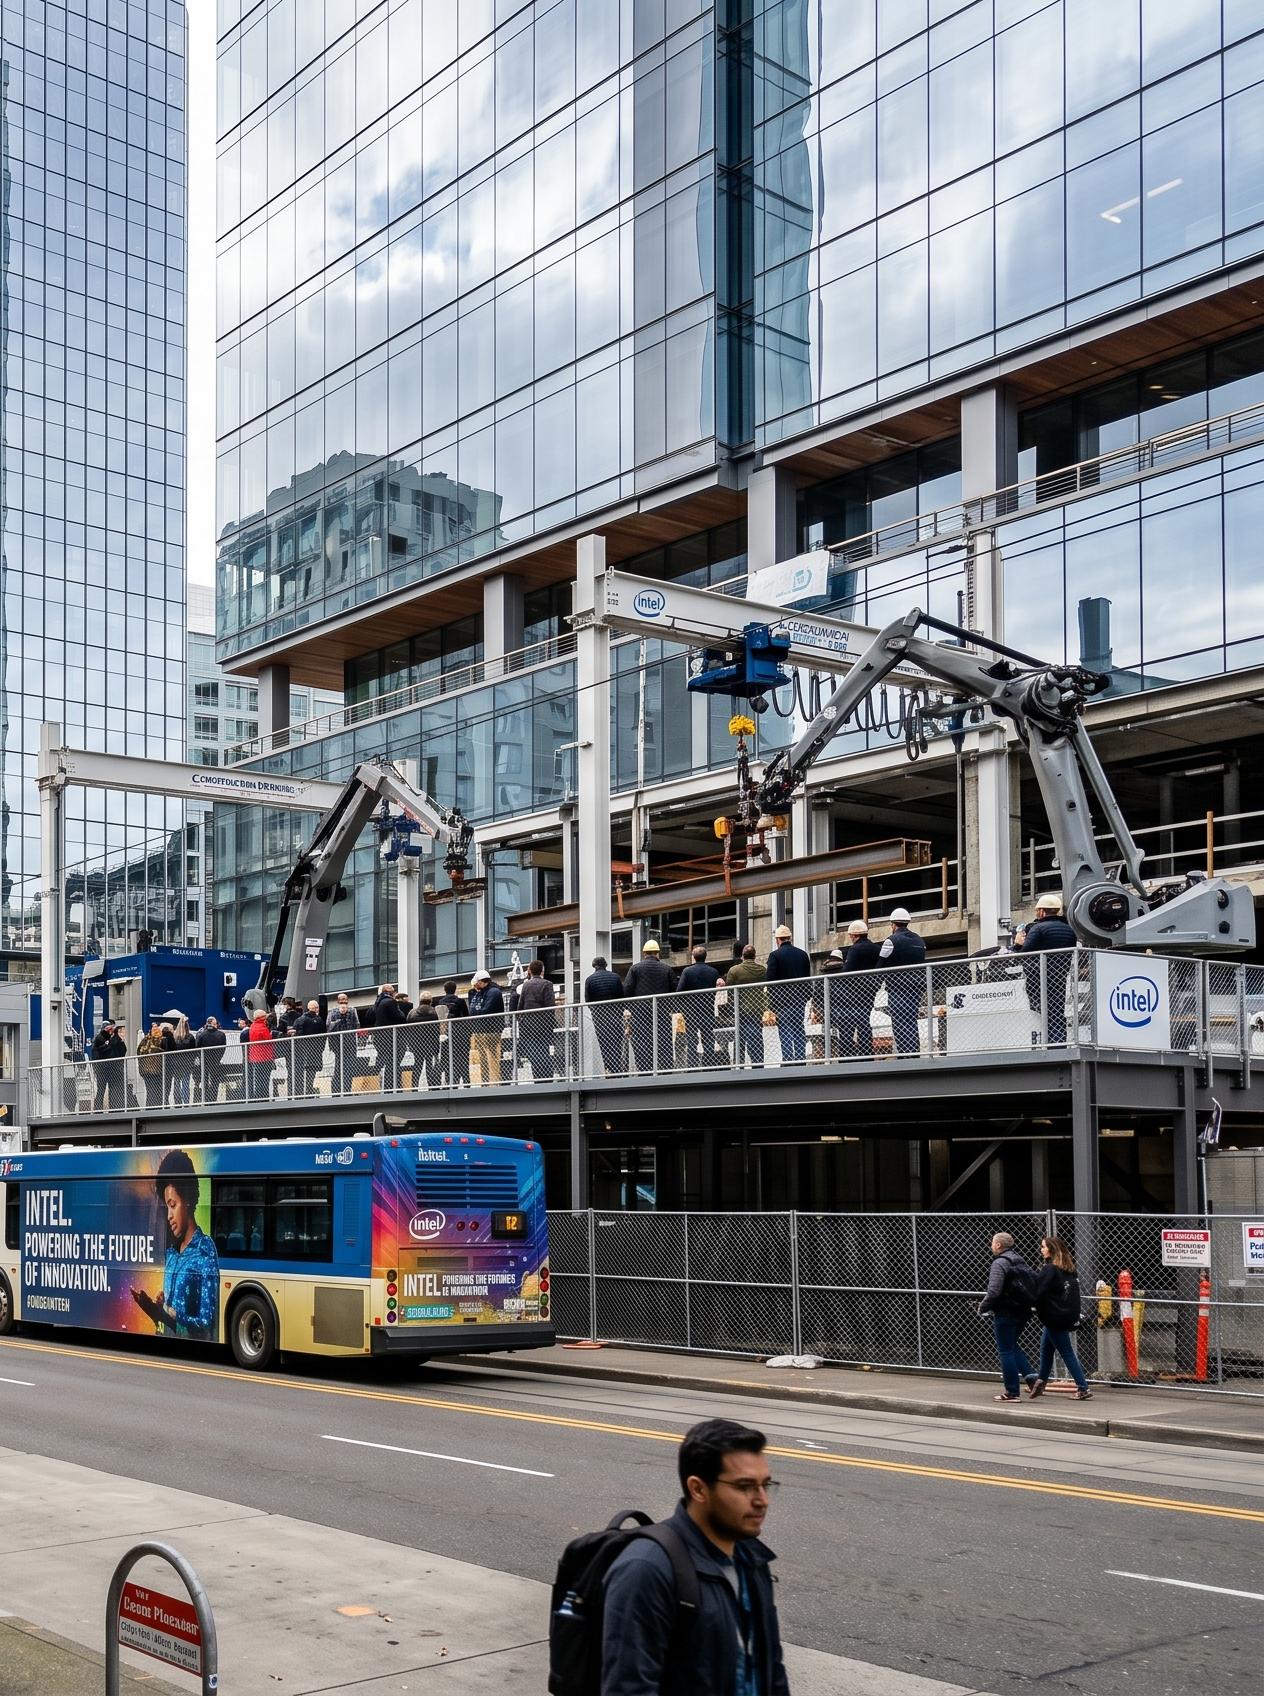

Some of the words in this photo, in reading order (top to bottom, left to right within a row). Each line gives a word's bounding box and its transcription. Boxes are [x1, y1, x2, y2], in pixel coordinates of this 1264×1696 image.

[26, 1190, 72, 1226] INTEL.
[25, 1232, 80, 1260] POWERING
[83, 1234, 105, 1261] THE
[108, 1234, 154, 1263] FUTURE
[25, 1261, 39, 1287] OF
[41, 1262, 111, 1292] INNOVATION.
[403, 1273, 441, 1297] INTEL
